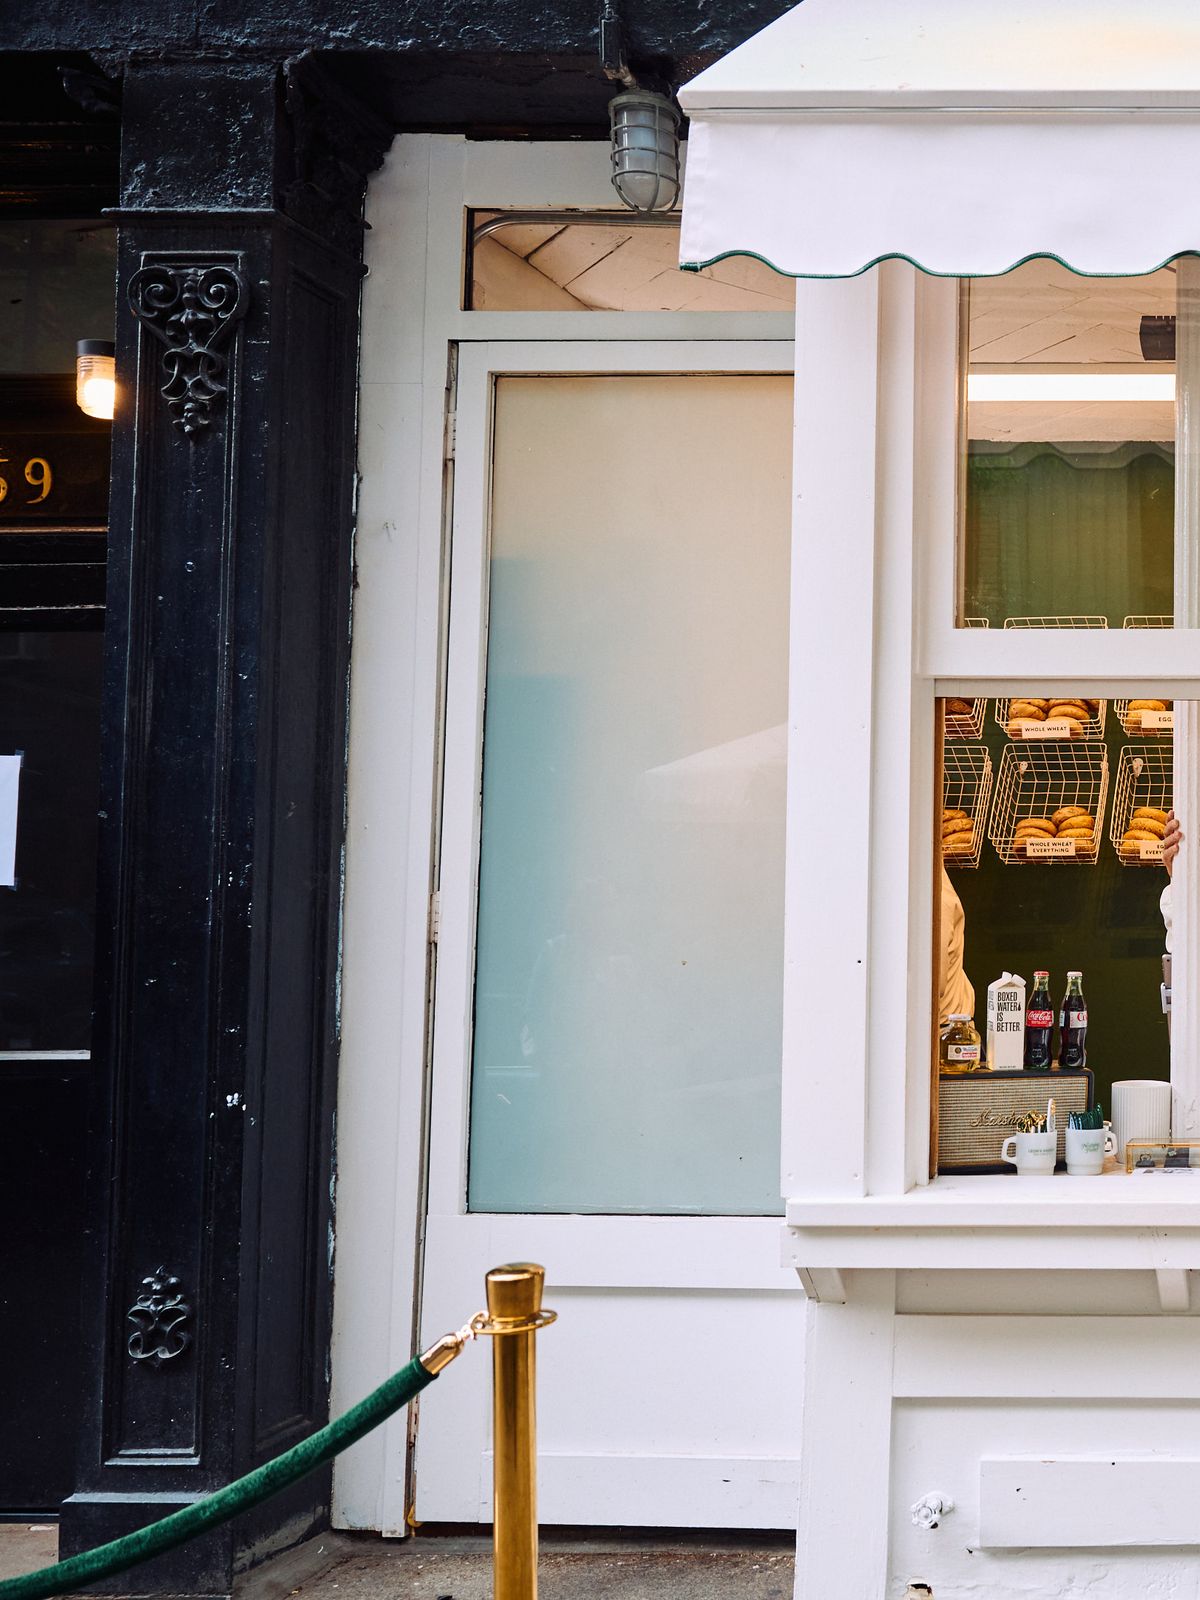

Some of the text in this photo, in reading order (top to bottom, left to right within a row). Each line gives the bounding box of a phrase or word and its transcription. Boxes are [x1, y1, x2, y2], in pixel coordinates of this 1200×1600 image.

[997, 991, 1018, 1002] BOXED
[997, 1002, 1018, 1012] WATER
[997, 1012, 1004, 1022] IS
